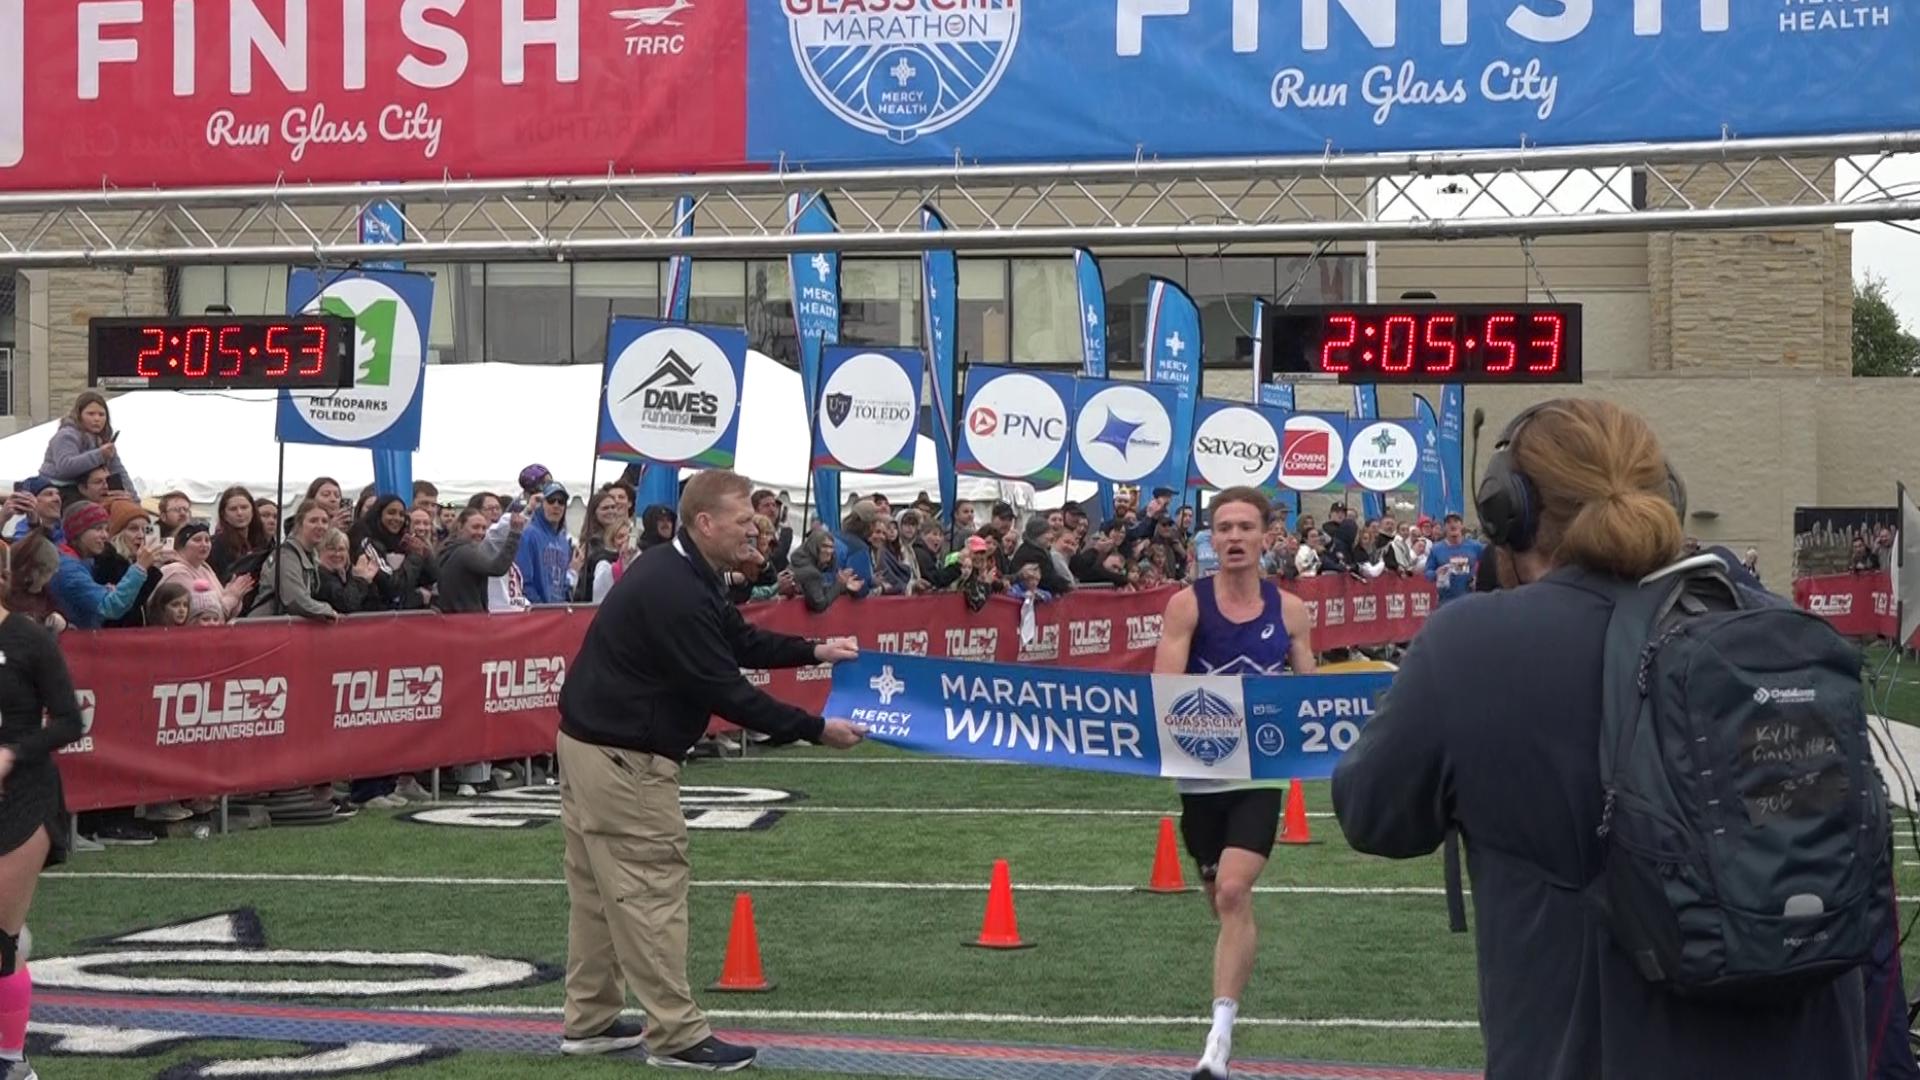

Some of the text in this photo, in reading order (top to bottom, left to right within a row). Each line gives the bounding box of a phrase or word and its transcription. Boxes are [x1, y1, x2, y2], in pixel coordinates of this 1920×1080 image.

[823, 14, 988, 41] MARATHON
[1778, 7, 1890, 32] HEALTH
[77, 0, 580, 99] FINISH
[624, 35, 685, 56] TRRC
[881, 90, 924, 102] MERCY
[1271, 57, 1559, 125] Run Glass City
[878, 103, 928, 115] HEALTH
[206, 101, 443, 162] Run Glass City
[309, 396, 388, 411] METROPARKS
[643, 387, 719, 415] DAVE'S
[853, 404, 911, 421] TOLEDO
[309, 408, 356, 422] TOLEDO
[1002, 412, 1063, 442] PNC
[1196, 435, 1276, 474] savage
[1284, 460, 1327, 471] CORNING
[1291, 452, 1327, 463] OWENS
[1362, 458, 1402, 469] MERCY
[1358, 469, 1405, 479] HEALTH
[877, 630, 928, 657] TOLEDO
[945, 627, 998, 656] TOLEDO
[1069, 618, 1112, 646] TOLEDO
[331, 665, 444, 714] TOLEDO
[481, 655, 566, 699] TOLEDO
[152, 676, 288, 728] TOLEDO
[544, 694, 561, 707] CLU
[940, 672, 1139, 717] MARATHON
[333, 705, 442, 729] ROADRUNNERS CLUB
[850, 708, 912, 724] MERCY
[1297, 697, 1375, 718] APRIL
[156, 719, 285, 747] ROADRUNNERS CLUB
[853, 722, 911, 738] ALTH
[944, 706, 1144, 759] WINNER
[1164, 713, 1244, 728] GLASS CITY
